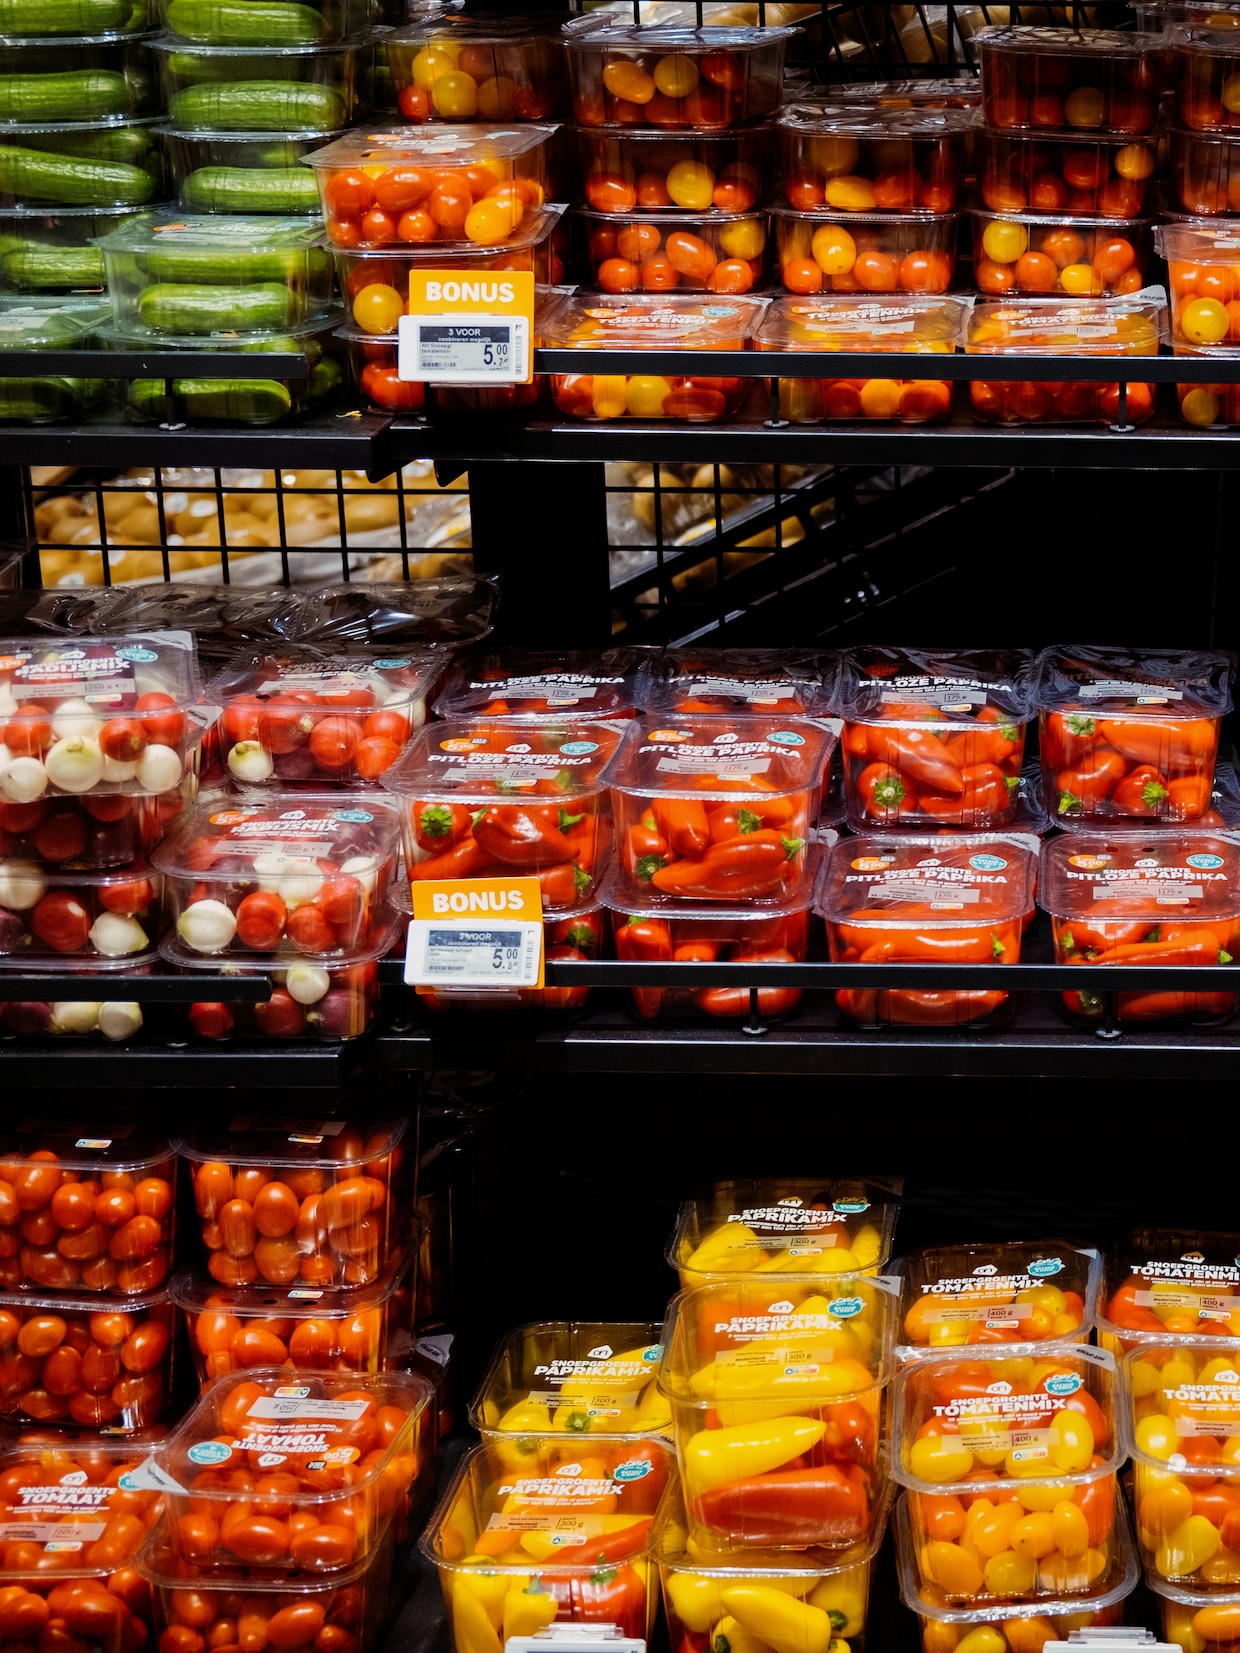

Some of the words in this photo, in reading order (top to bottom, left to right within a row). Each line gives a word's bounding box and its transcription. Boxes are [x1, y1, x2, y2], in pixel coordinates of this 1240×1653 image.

[426, 282, 514, 302] BONUS
[599, 316, 720, 325] TOMATENMIX
[448, 328, 453, 336] 3
[456, 328, 481, 336] VOOR
[545, 675, 625, 684] PAPRIKA
[858, 678, 929, 688] PITLOZE
[934, 678, 1012, 692] PAPRIKA
[639, 744, 718, 756] PITLOZE
[721, 745, 801, 758] PAPRIKA
[427, 755, 504, 764] PITLOZE
[508, 757, 592, 766] PAPRIKA
[231, 823, 340, 833] RADIJSMIX
[846, 872, 921, 883] PITLOZE
[925, 872, 1008, 883] PAPRIKA
[1066, 871, 1141, 881] PITLOZE
[1145, 872, 1228, 881] PAPRIKA
[433, 890, 524, 912] BONUS
[467, 932, 492, 940] VOOR
[742, 1208, 835, 1216] SNOEPGROENTE
[727, 1213, 848, 1222] PAPRIKAMIX
[1147, 1262, 1237, 1272] SNOEPGROENTE
[938, 1275, 1030, 1285] SNOEPGROENTE
[921, 1279, 1045, 1294] TOMATENMIX
[730, 1314, 829, 1324] SNOEPGROENTE
[715, 1320, 842, 1333] PAPRIKAMIX
[534, 1365, 653, 1375] PAPRIKAMIX
[950, 1394, 1049, 1406] SNOEPGROENTE
[933, 1399, 1067, 1417] TOMATENMIX
[241, 1433, 326, 1447] TOMAAT
[231, 1440, 329, 1452] SNOEPGROENTE
[516, 1478, 614, 1486] SNOEPGROENTE
[17, 1487, 117, 1495] SNOEPGROENTE
[498, 1484, 625, 1496] PAPRIKAMIX
[22, 1494, 107, 1504] TOMAAT
